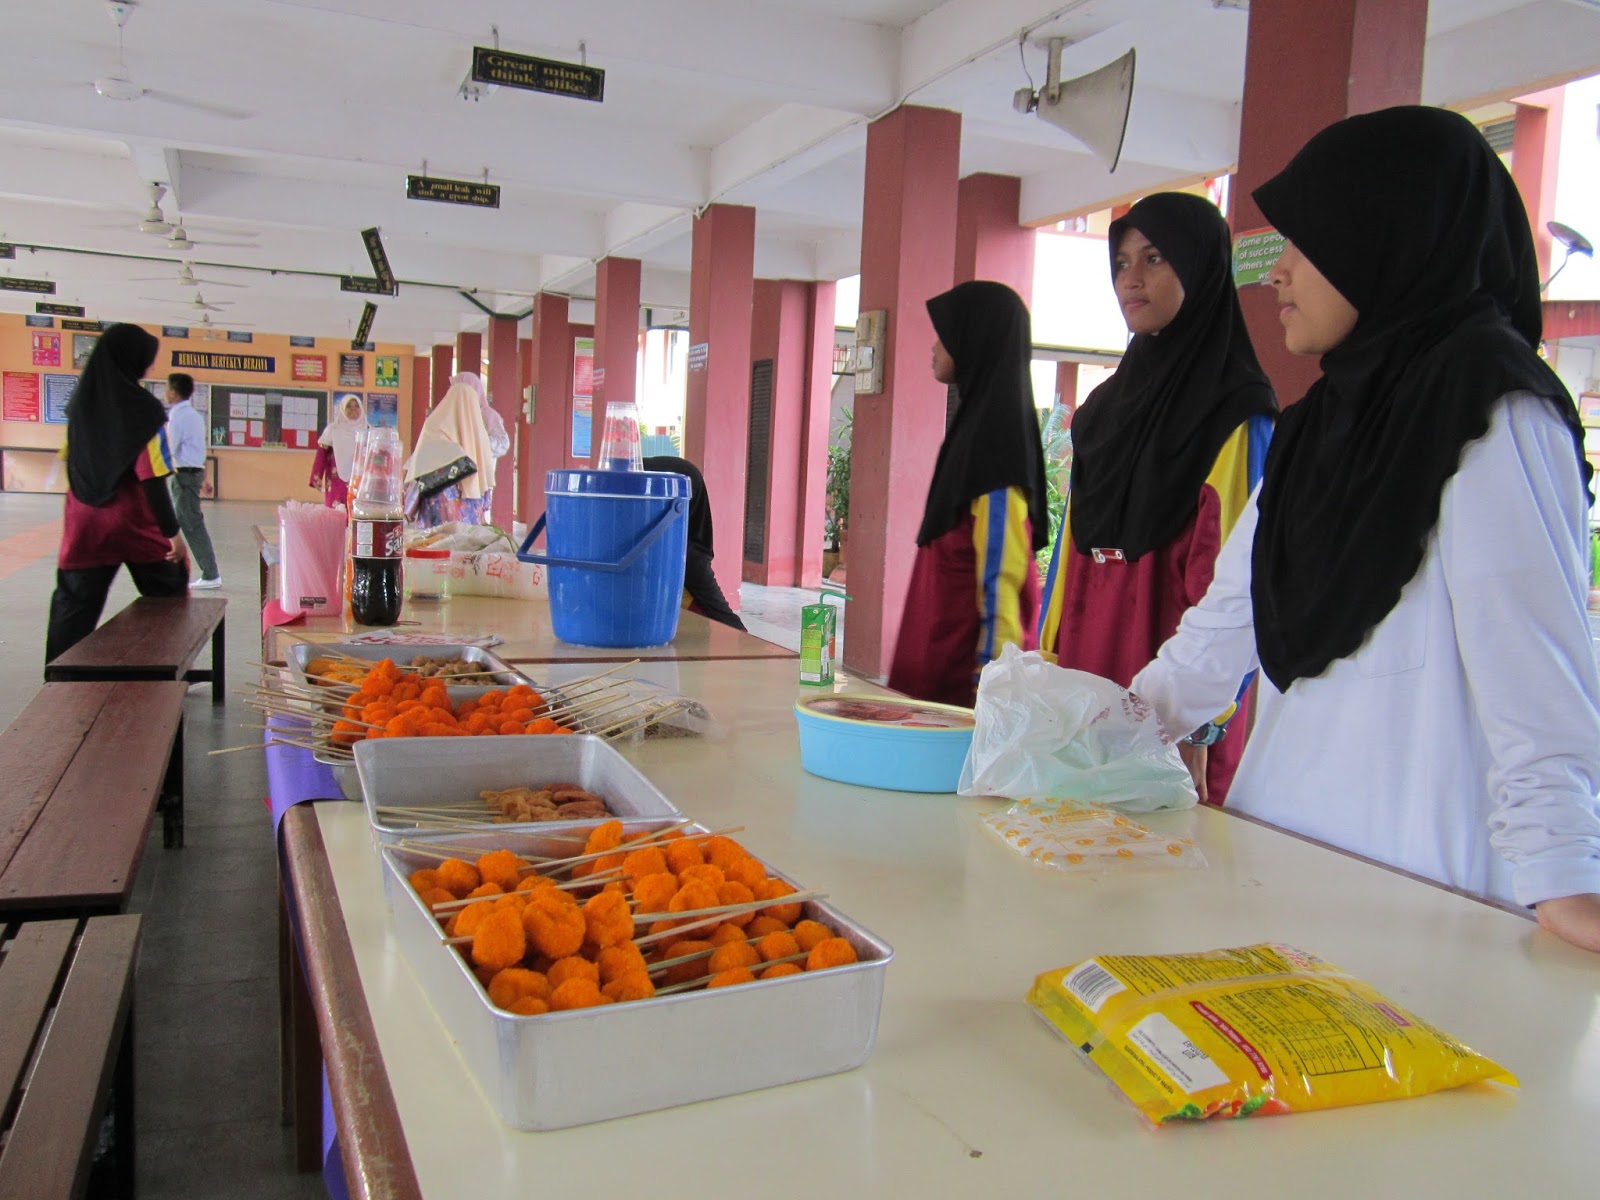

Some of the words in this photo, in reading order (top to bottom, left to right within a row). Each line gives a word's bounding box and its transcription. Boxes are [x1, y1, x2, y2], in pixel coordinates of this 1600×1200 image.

[487, 55, 535, 72] Great
[543, 66, 592, 81] minds
[490, 68, 534, 84] think
[417, 180, 424, 188] A
[454, 184, 470, 193] leak
[1239, 237, 1260, 248] Some
[1239, 250, 1248, 260] of
[1249, 245, 1283, 257] success
[1238, 261, 1263, 271] others
